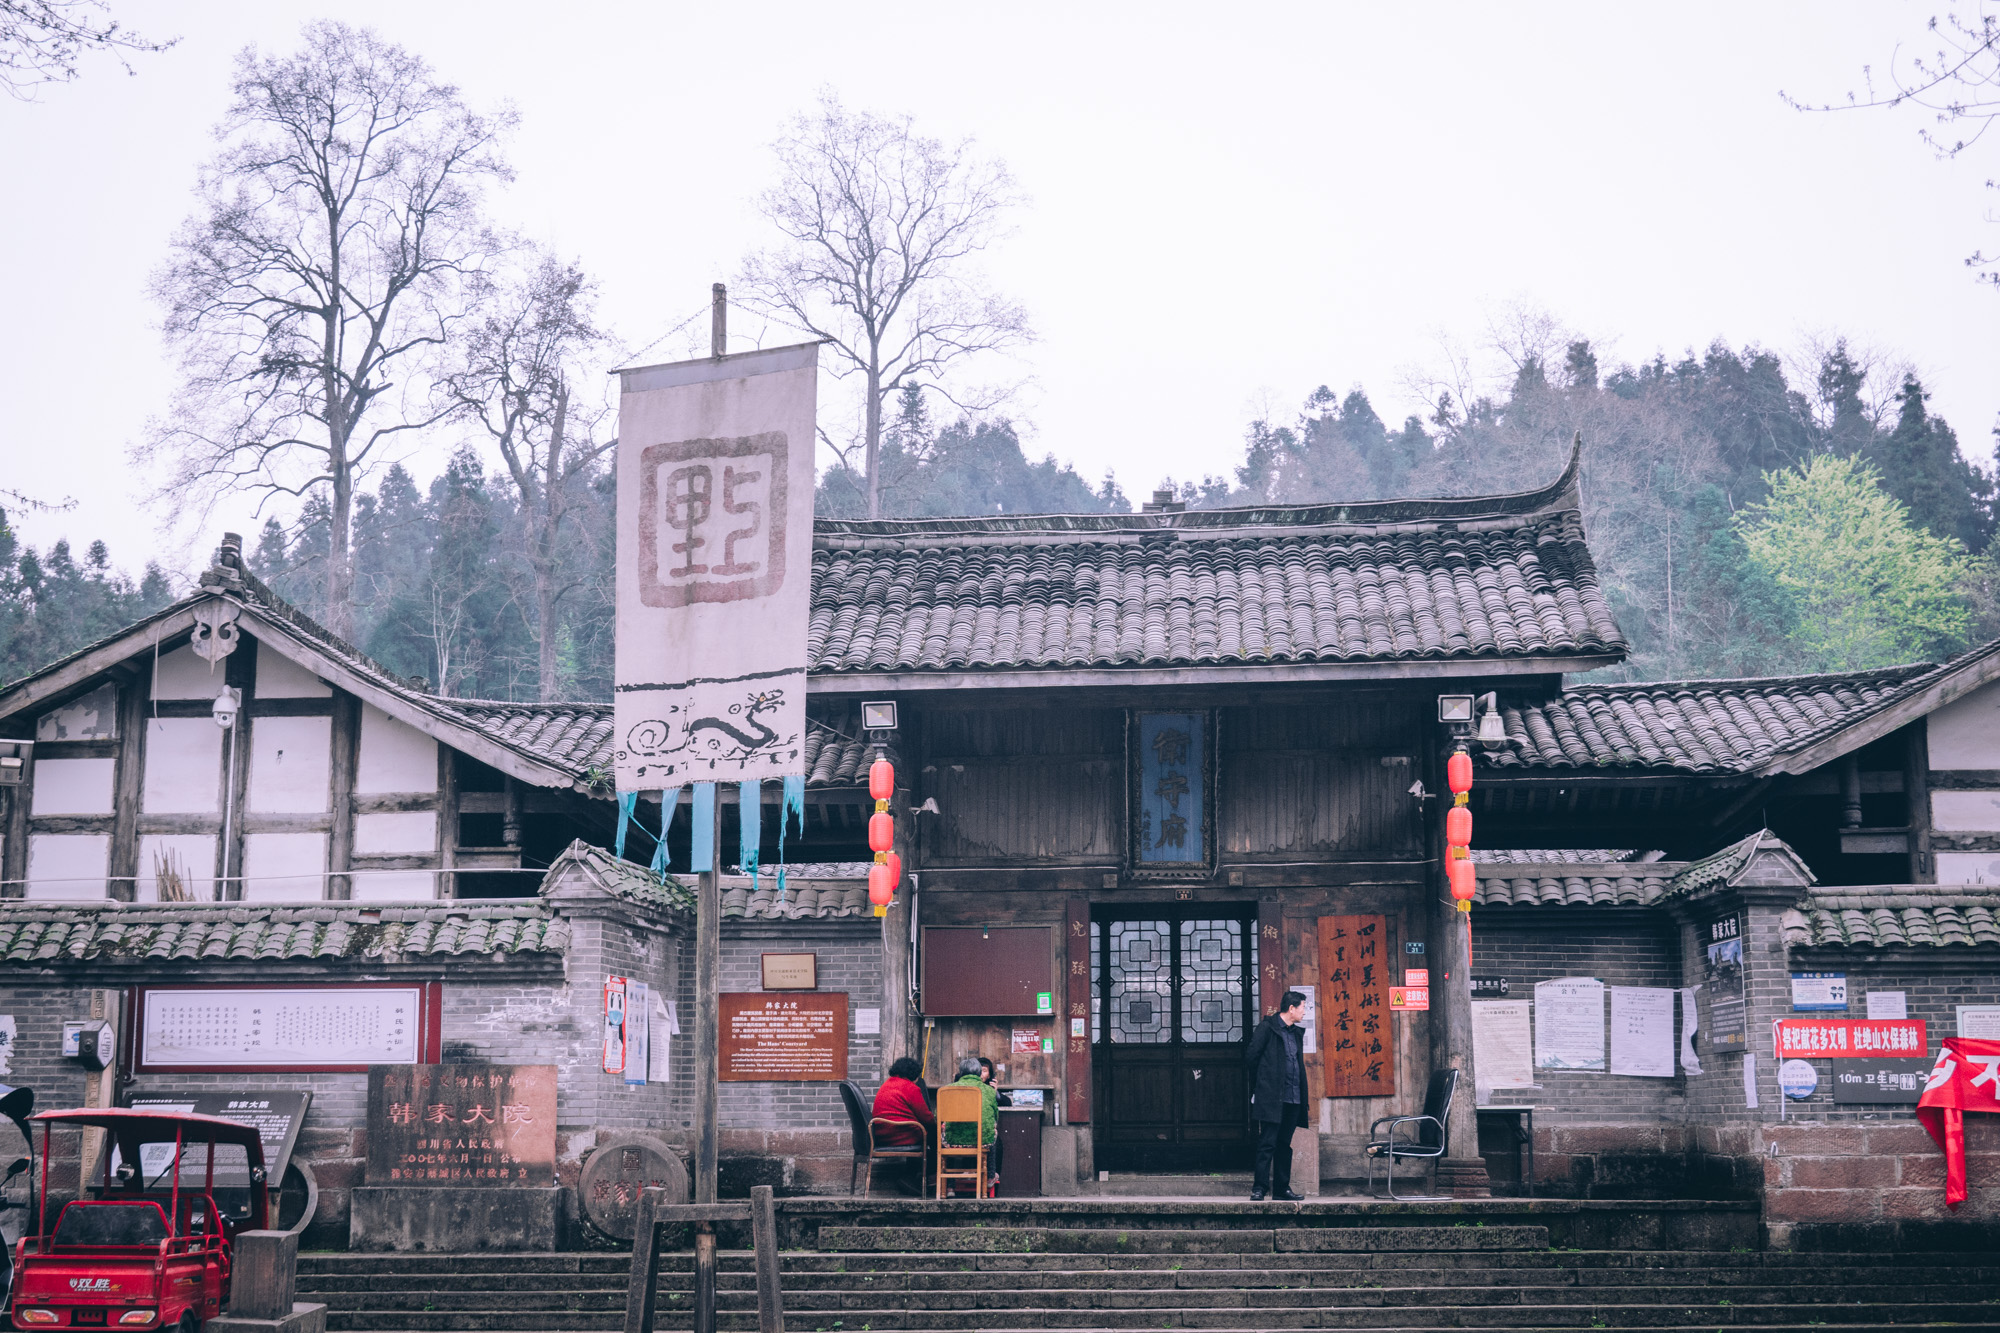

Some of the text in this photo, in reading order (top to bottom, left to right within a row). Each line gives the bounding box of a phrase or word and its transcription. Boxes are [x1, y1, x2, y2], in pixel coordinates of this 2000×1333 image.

[1711, 917, 1738, 941] 韩家大院
[1405, 990, 1427, 1001] 注意防火
[765, 1001, 798, 1010] 韩家大院
[1782, 1026, 1919, 1051] 祭祀献花多文明 杜绝山火保森林
[1838, 1073, 1899, 1084] 10m 卫生间
[227, 1100, 270, 1110] 韩家大院
[386, 1101, 534, 1125] 韩家大院
[416, 1138, 505, 1150] 四川省人民政府
[500, 1153, 521, 1164] 公布
[518, 1167, 529, 1179] 立
[77, 1278, 111, 1288] 双胜
